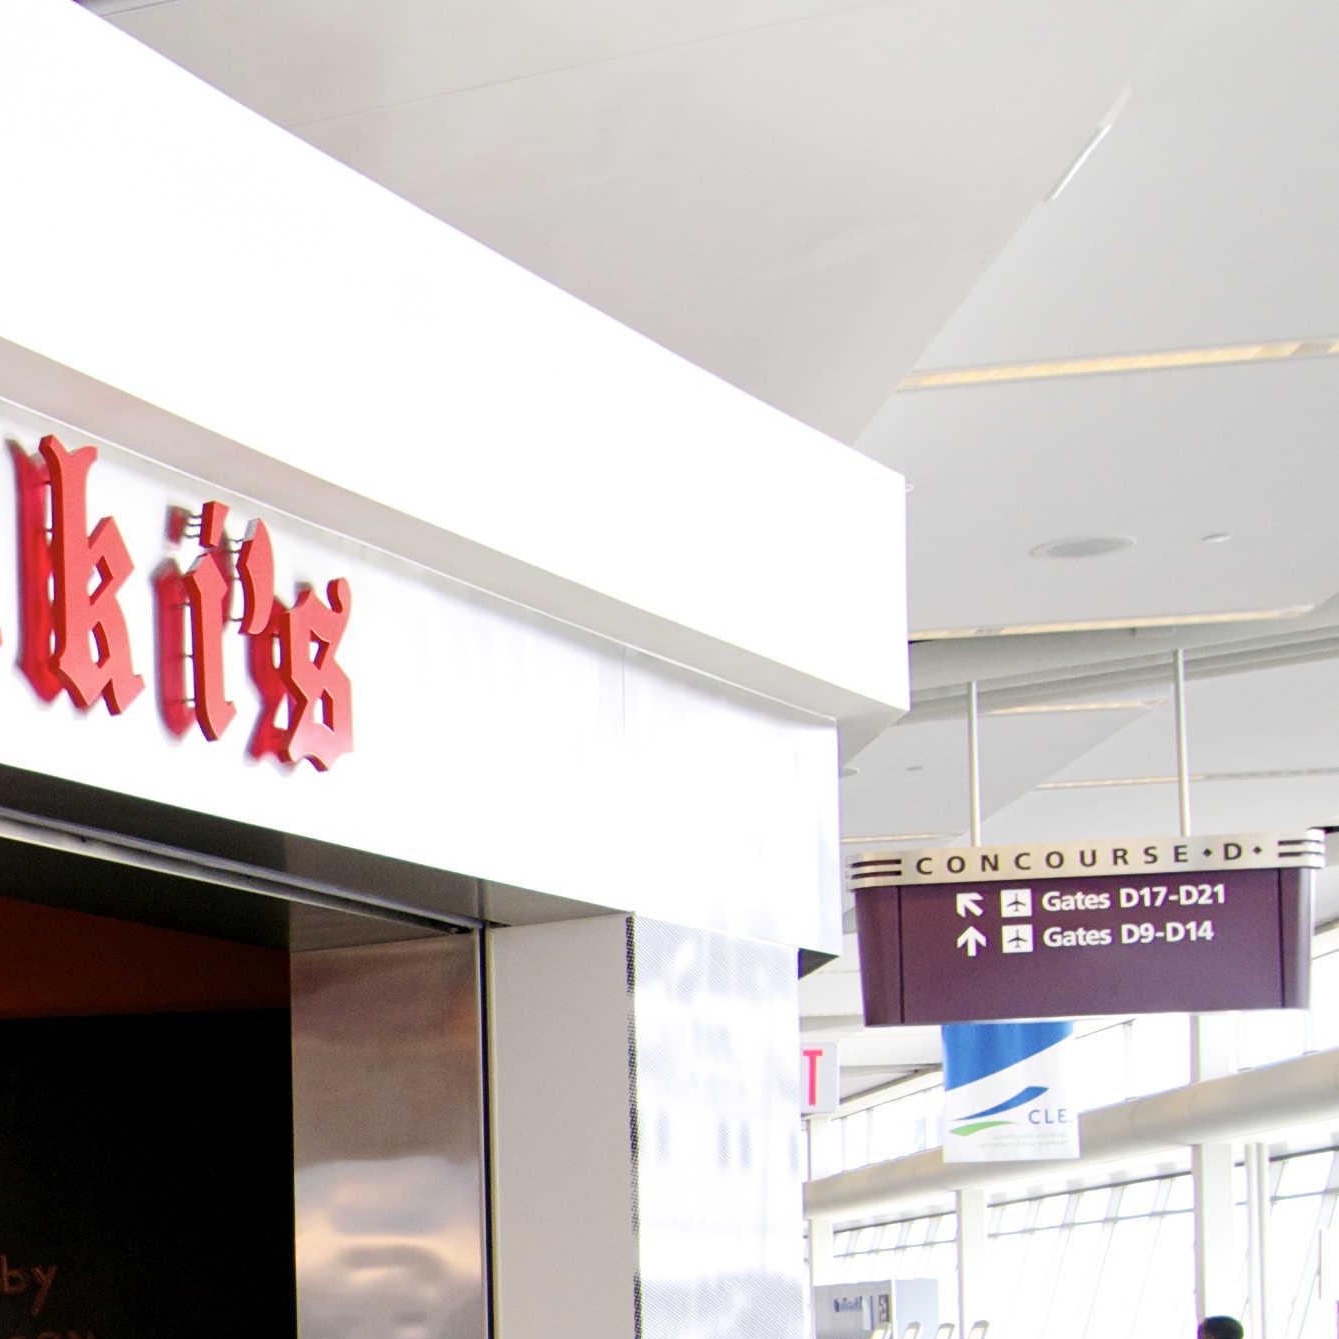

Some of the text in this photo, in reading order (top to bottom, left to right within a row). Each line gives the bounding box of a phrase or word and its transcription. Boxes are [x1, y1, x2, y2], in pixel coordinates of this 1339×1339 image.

[916, 845, 1188, 876] CONCOURSE
[1042, 884, 1226, 912] Gates D17-D21
[1043, 920, 1214, 948] Gates D9-D14
[1028, 1109, 1067, 1125] CLE
